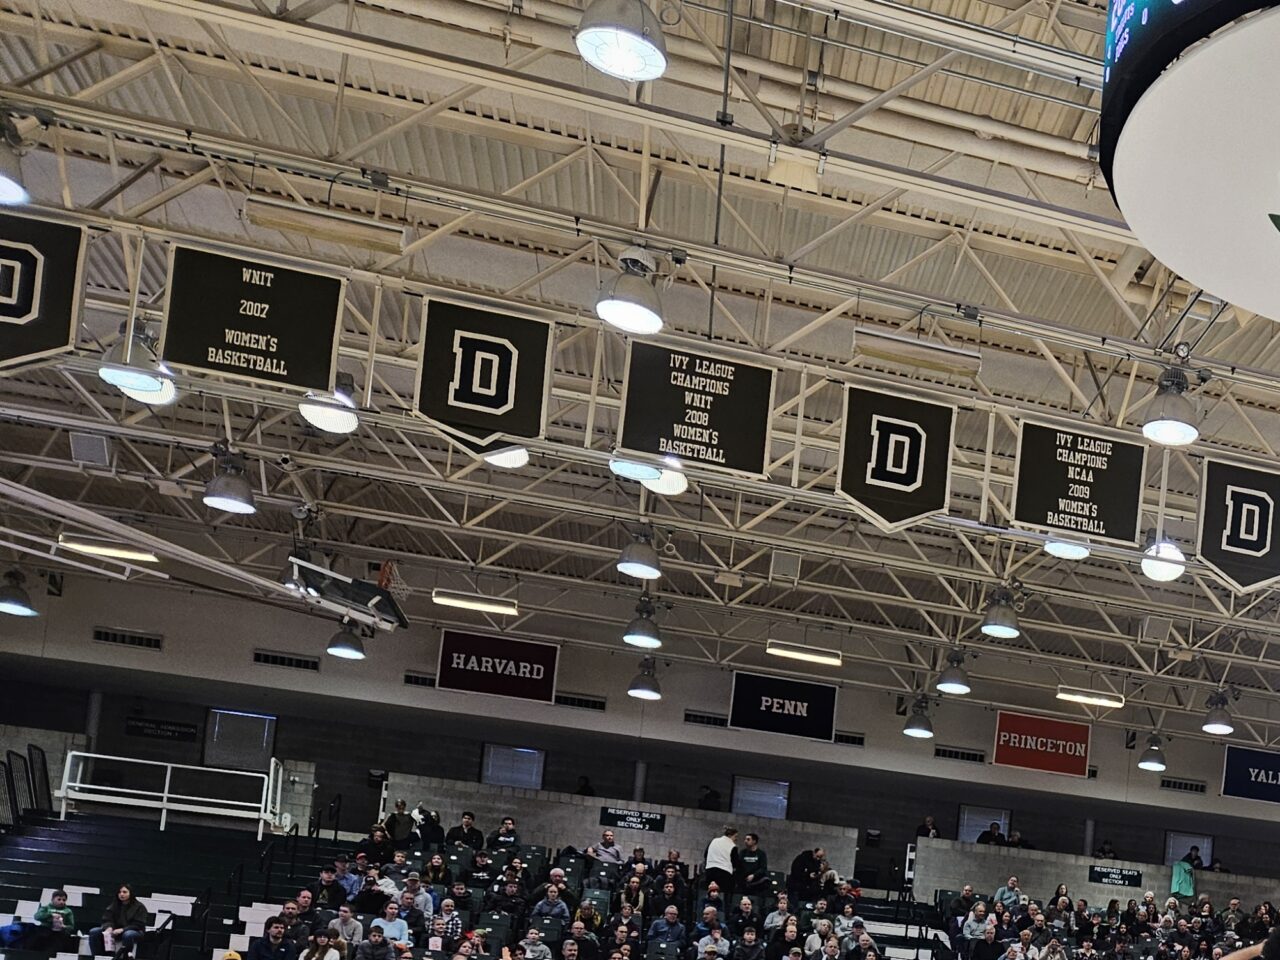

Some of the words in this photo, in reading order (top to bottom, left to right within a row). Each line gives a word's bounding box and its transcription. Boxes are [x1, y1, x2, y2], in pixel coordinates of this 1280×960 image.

[242, 268, 274, 287] WNIT
[239, 300, 270, 319] 2007
[224, 328, 278, 352] WOMEN'S
[208, 347, 288, 376] BASKETBALL
[448, 329, 518, 415] D
[669, 354, 690, 372] IVY
[696, 358, 736, 380] LEAGUE
[670, 371, 730, 396] CHAMPIONS
[684, 391, 713, 410] WNIT
[684, 409, 709, 426] 2008
[673, 423, 718, 445] WOMEN'S
[1056, 432, 1073, 448] IVY
[1077, 436, 1113, 456] LEAGUE
[659, 437, 726, 464] BASKETBALL
[865, 414, 927, 493] D
[1056, 448, 1108, 470] CHAMPIONS
[1068, 466, 1094, 483] NCAA
[1068, 484, 1090, 500] 2009
[1058, 498, 1098, 518] WOMEN'S
[1047, 512, 1106, 534] BASKETBALL
[1221, 484, 1274, 558] D
[451, 652, 544, 680] HARVARD
[760, 696, 808, 718] PENN
[998, 732, 1086, 758] PRINCETON
[608, 808, 640, 816] RESERVED
[642, 812, 660, 820] SEATS
[1094, 866, 1120, 874] RESERVED
